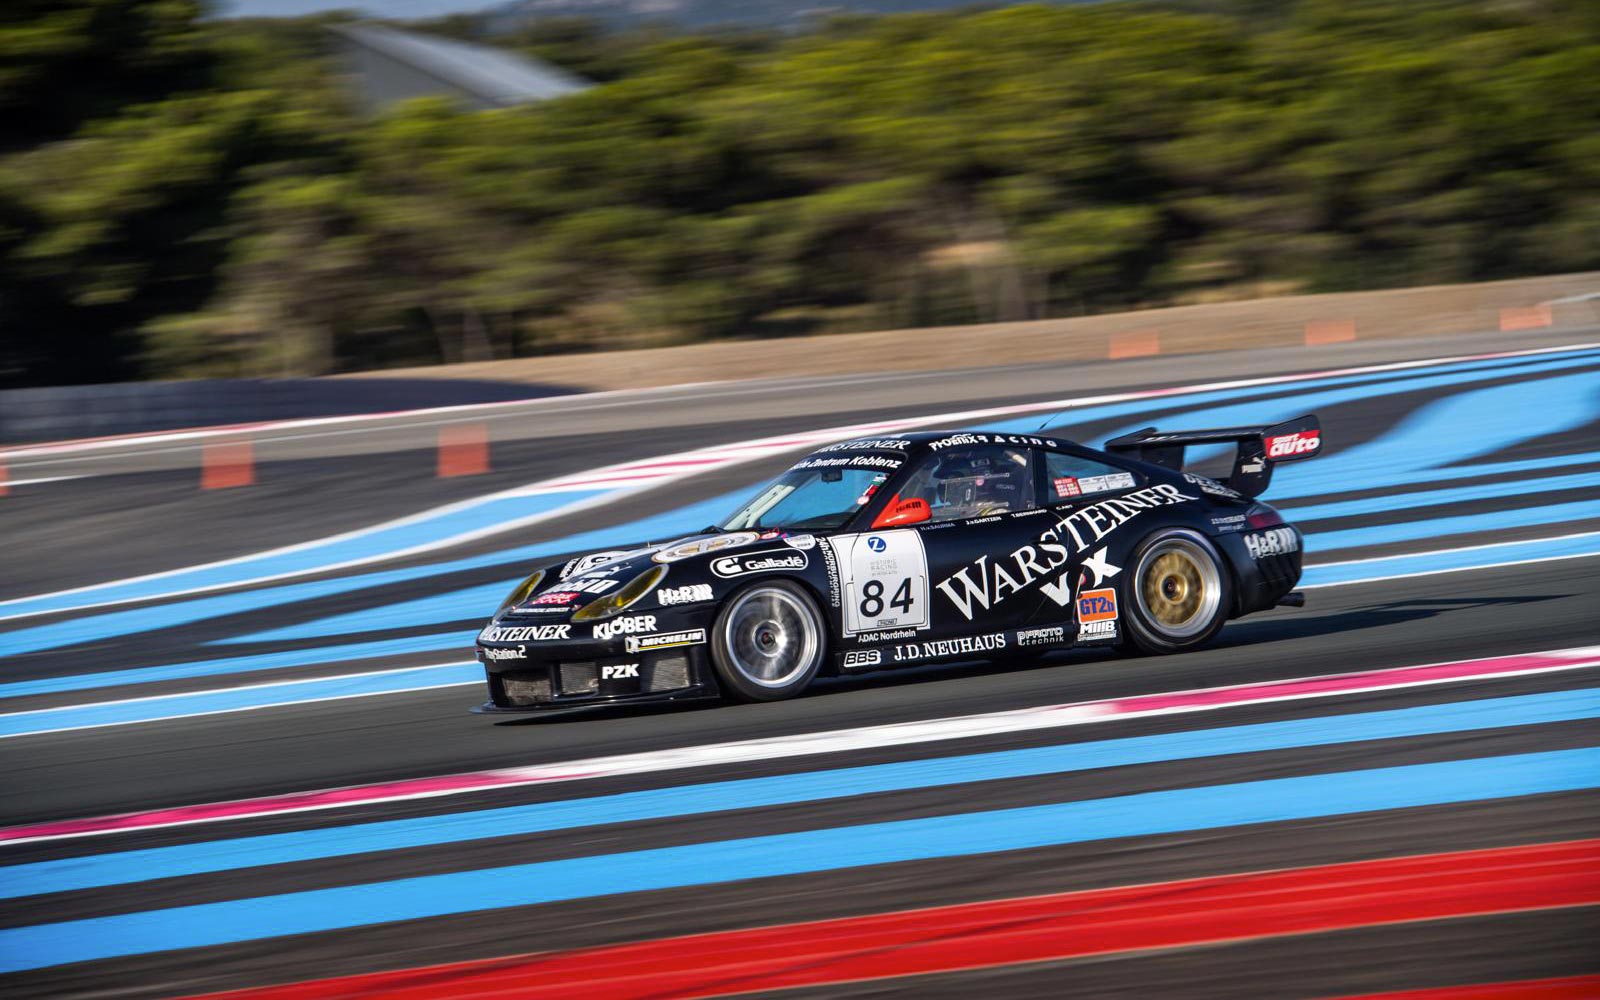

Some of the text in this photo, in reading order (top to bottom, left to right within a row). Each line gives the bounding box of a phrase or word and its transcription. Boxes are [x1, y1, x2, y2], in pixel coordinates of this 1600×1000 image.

[1269, 437, 1320, 456] auto
[848, 455, 903, 469] Koblenz
[936, 484, 1199, 621] WARSTEINER
[1244, 528, 1291, 560] H&R
[657, 584, 706, 605] H&R
[860, 577, 914, 617] 84
[480, 623, 572, 642] STEINER
[641, 632, 702, 647] MICHELIN
[880, 629, 917, 641] Nordrhein
[845, 650, 880, 667] BBS
[602, 664, 640, 679] PZK
